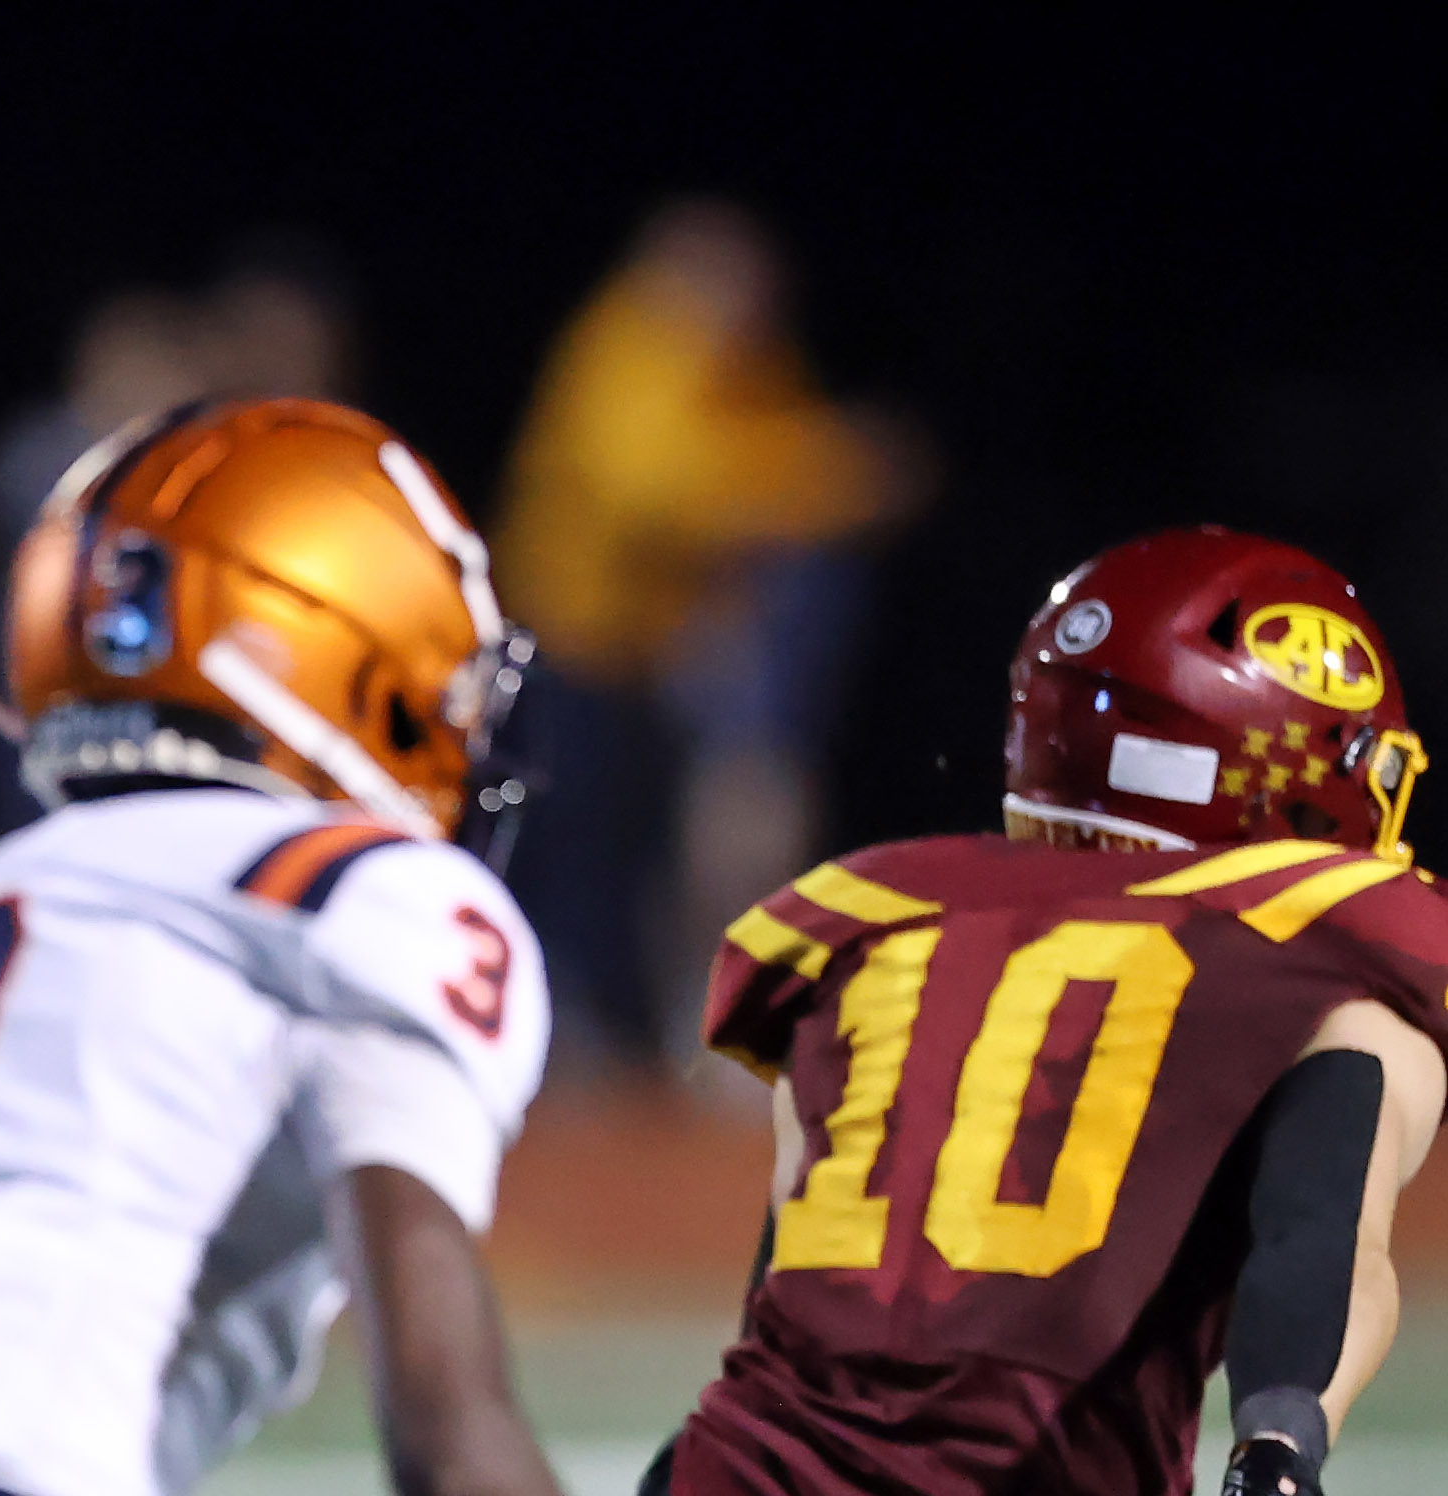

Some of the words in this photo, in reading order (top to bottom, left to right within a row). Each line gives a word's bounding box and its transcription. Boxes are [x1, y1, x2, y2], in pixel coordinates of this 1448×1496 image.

[1253, 614, 1380, 698] AL
[441, 903, 512, 1041] 3
[770, 918, 1195, 1279] 10
